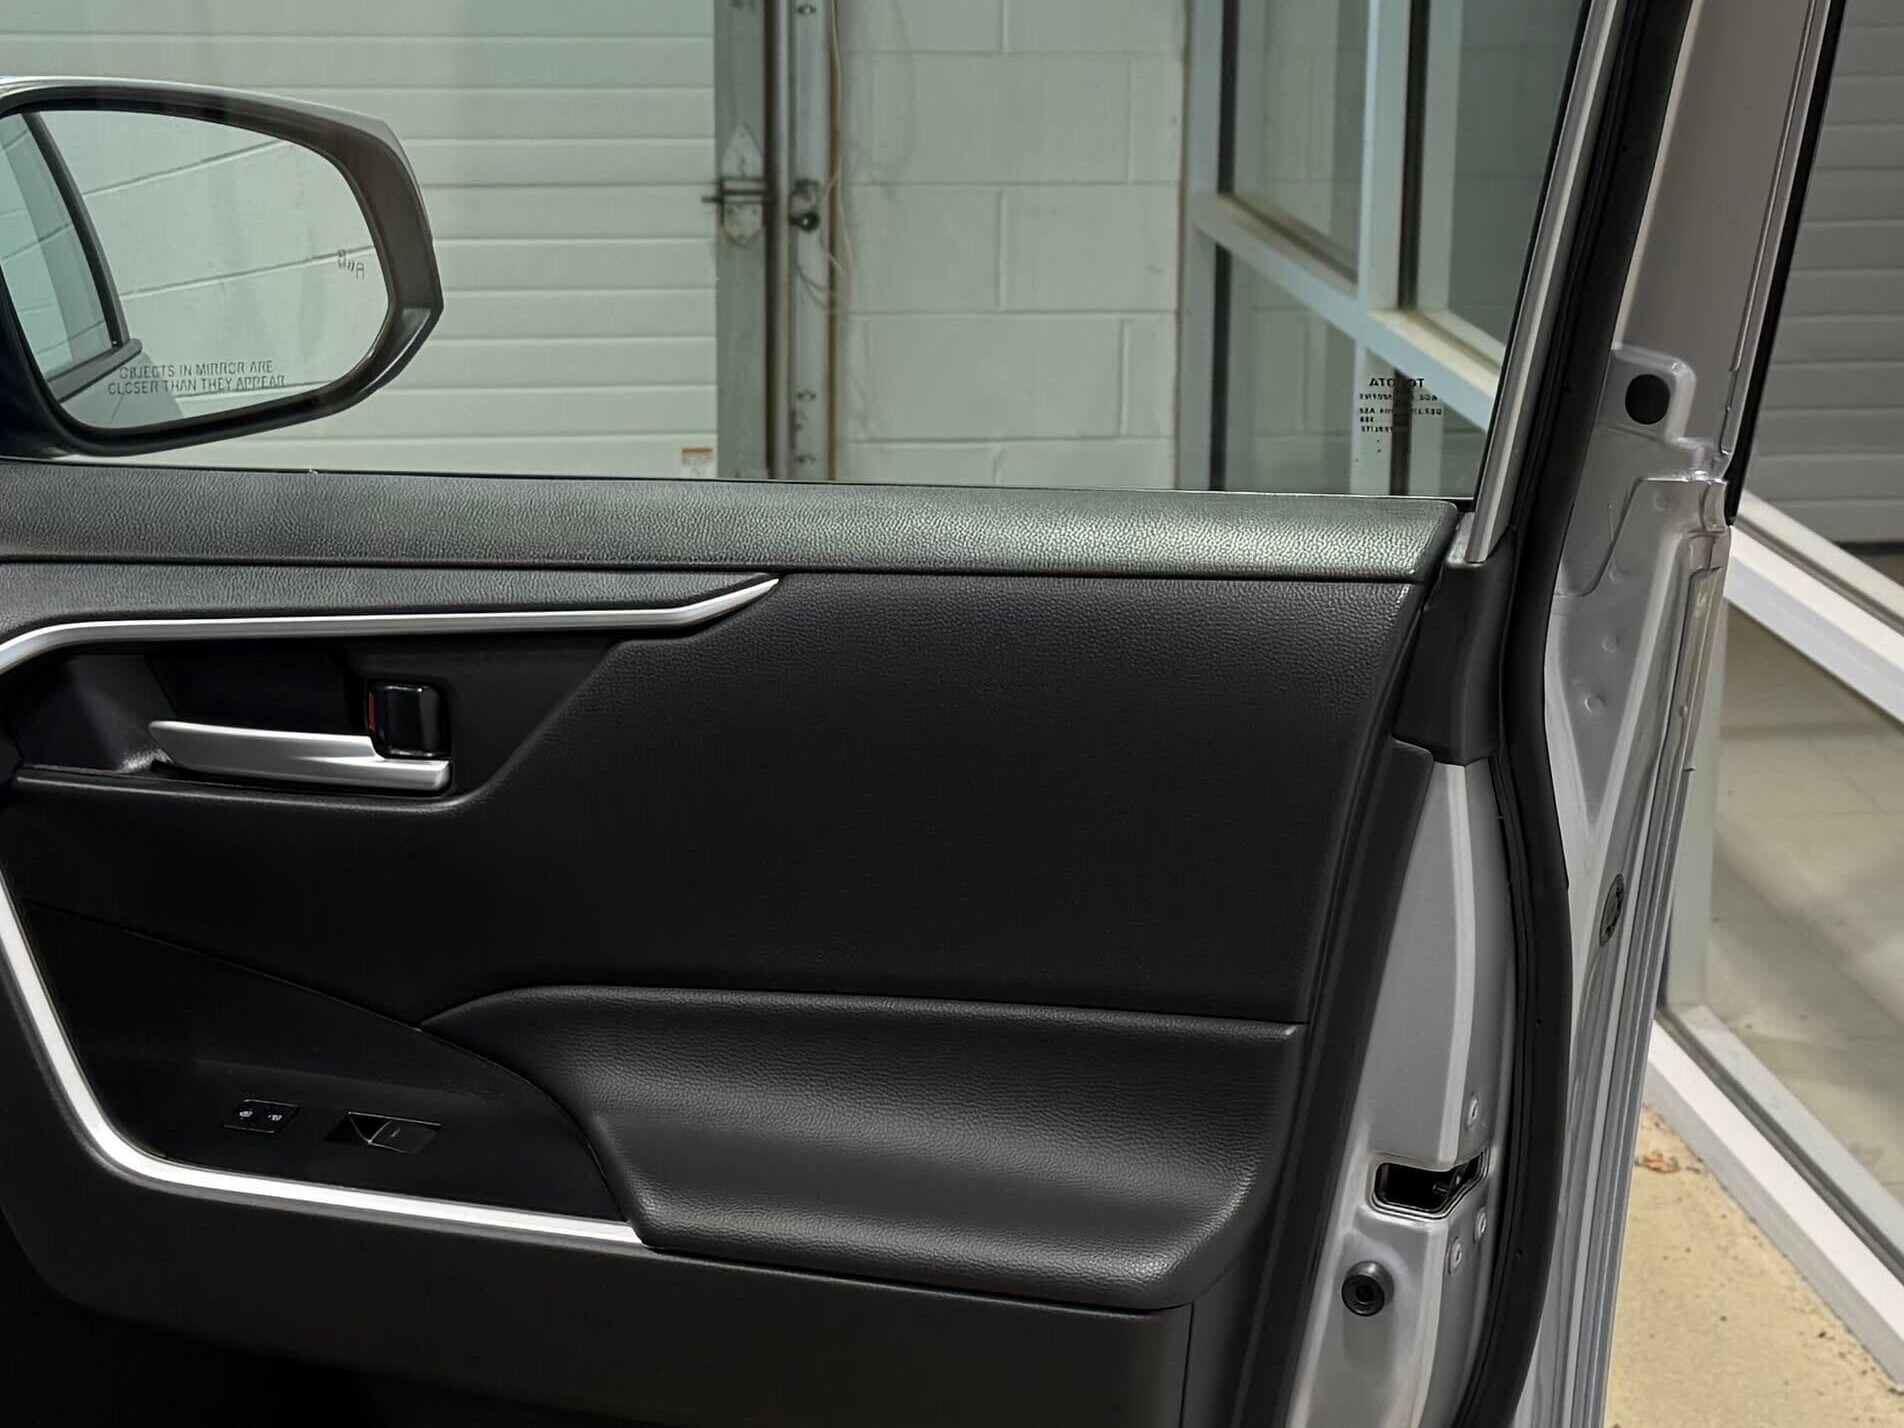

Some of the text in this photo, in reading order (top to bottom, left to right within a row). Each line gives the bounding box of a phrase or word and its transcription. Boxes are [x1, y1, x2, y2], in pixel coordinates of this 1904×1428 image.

[119, 359, 274, 380] OBJECTS IN MIRROR ARE
[108, 375, 288, 396] CLOSER THAN THEY APPEAR
